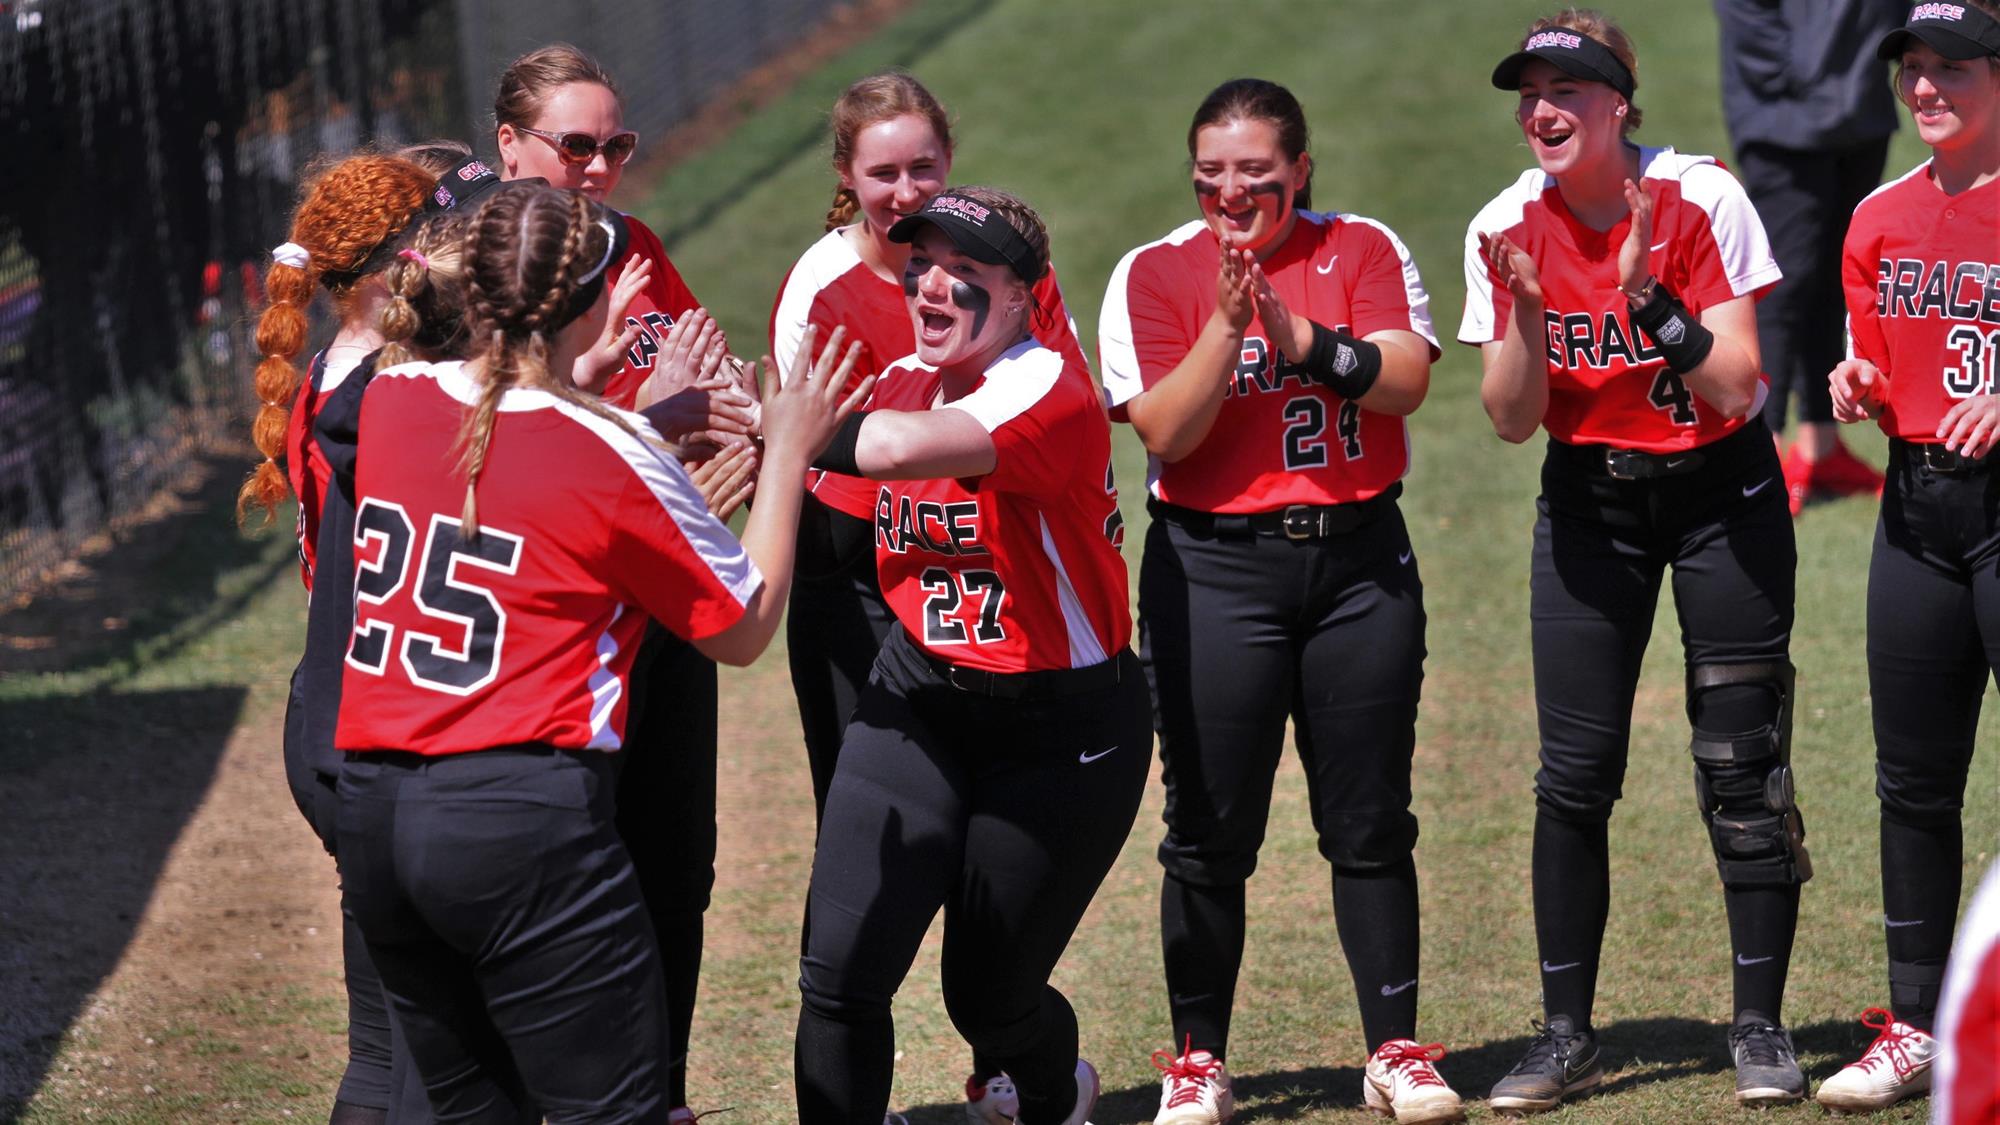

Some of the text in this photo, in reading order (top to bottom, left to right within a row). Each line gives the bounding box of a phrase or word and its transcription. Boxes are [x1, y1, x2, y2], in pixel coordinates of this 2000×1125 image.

[1912, 3, 1965, 20] GRACE
[1527, 32, 1582, 49] GRACE
[932, 197, 990, 222] GRACE
[936, 208, 971, 222] SOFTBALL
[1647, 366, 1699, 425] 4
[1283, 396, 1363, 471] 24
[345, 496, 524, 696] 25
[920, 566, 1007, 646] 27
